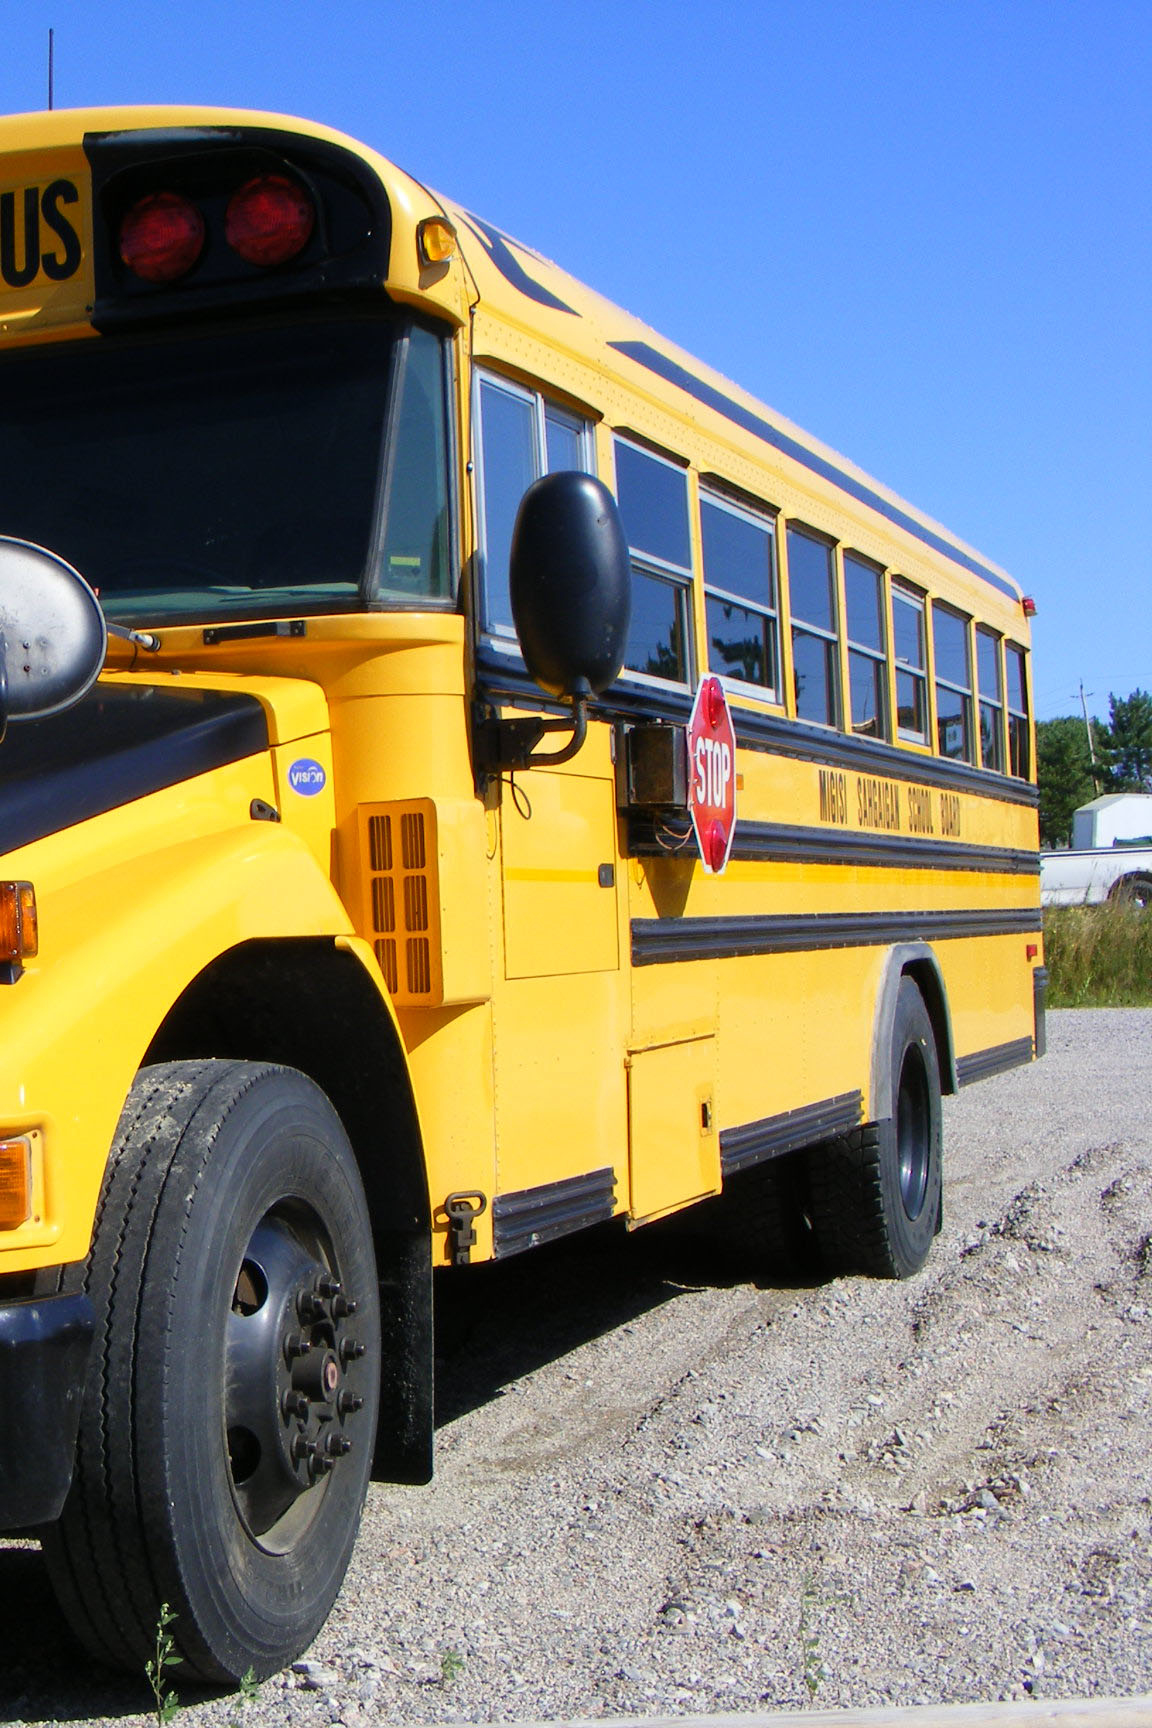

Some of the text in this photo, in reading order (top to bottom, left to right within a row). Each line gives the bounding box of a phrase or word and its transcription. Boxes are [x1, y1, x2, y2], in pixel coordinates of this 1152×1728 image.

[696, 735, 731, 809] STOP
[818, 769, 848, 825] MIGISI
[907, 786, 934, 834] SCHOOL
[940, 792, 961, 837] BOARD
